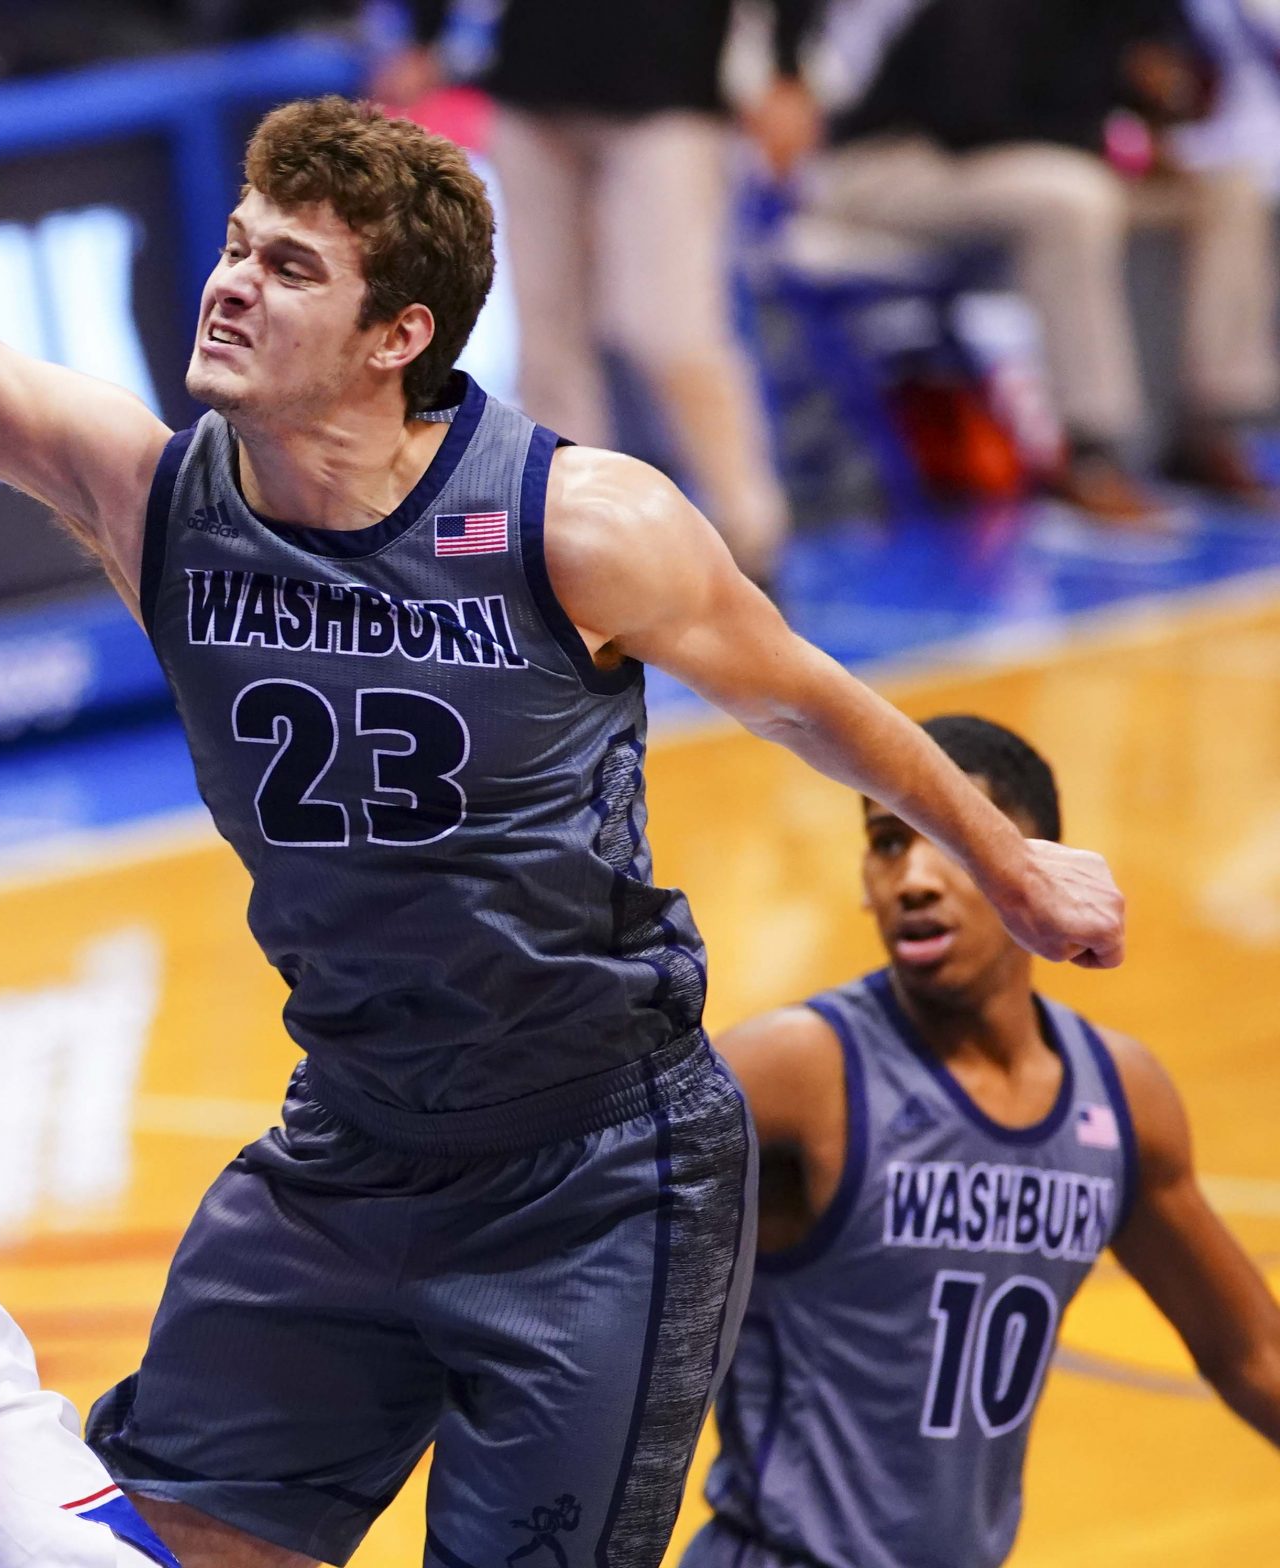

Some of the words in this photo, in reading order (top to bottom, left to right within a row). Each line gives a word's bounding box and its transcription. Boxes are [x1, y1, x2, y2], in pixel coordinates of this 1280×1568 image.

[187, 517, 239, 538] adidas
[185, 568, 528, 669] WASHBURN
[231, 678, 470, 847] 23
[882, 1161, 1115, 1263] WASHBURN
[921, 1269, 1058, 1439] 10
